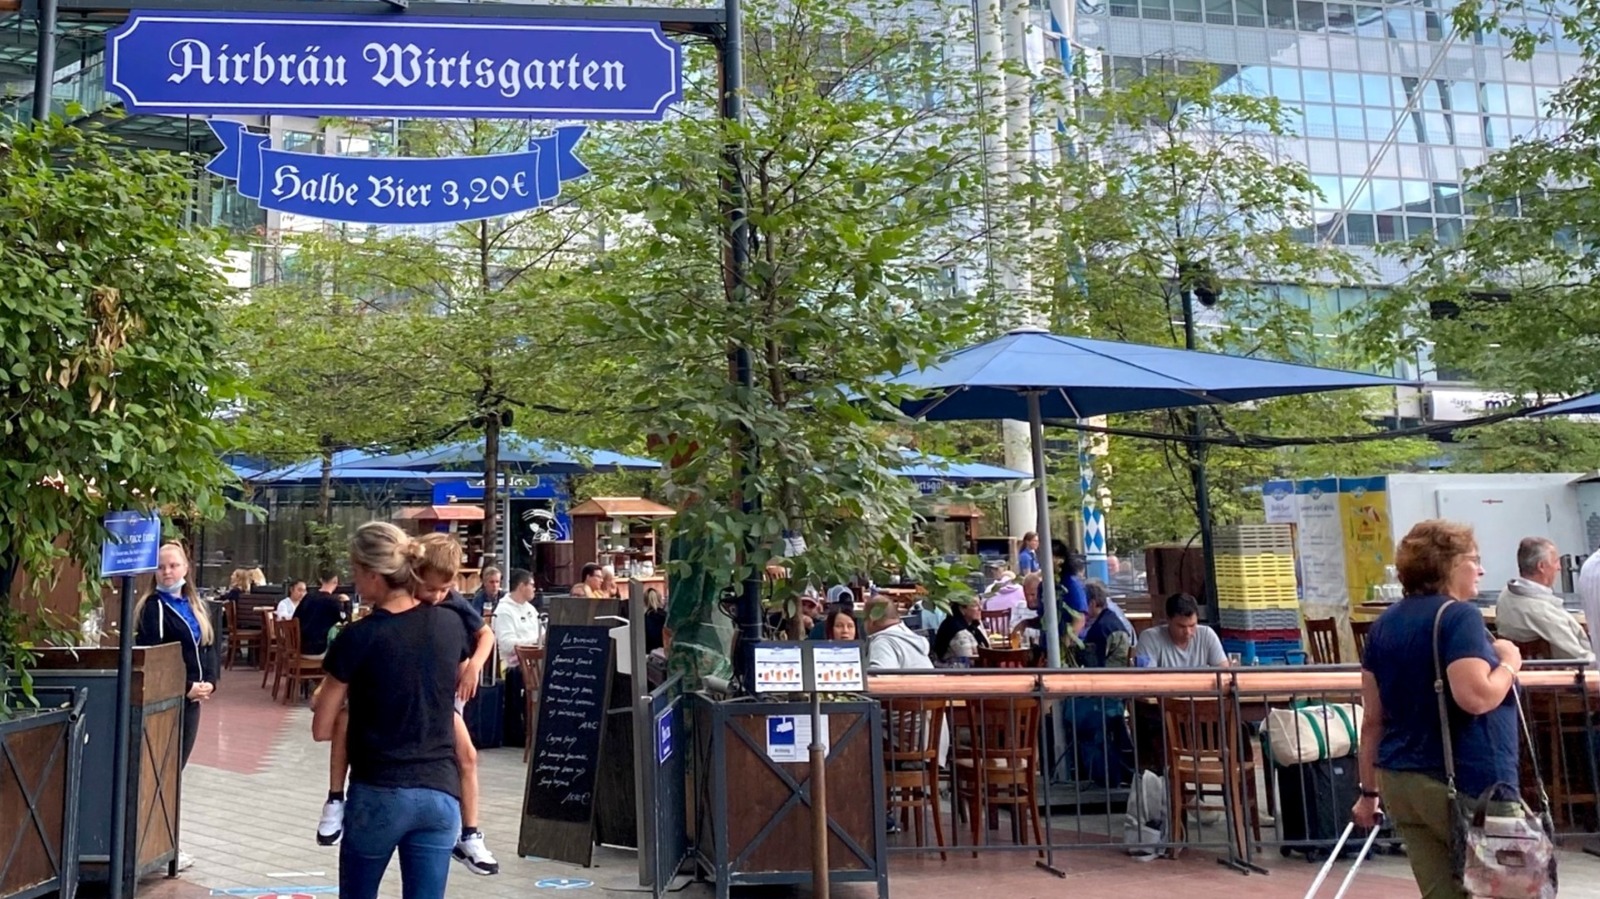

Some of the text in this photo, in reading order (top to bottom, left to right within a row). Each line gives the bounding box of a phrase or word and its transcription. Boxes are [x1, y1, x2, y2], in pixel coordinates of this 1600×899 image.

[167, 38, 628, 98] Airbräu Wirtsgarten
[271, 164, 529, 210] Halbe Bier 3,20€
